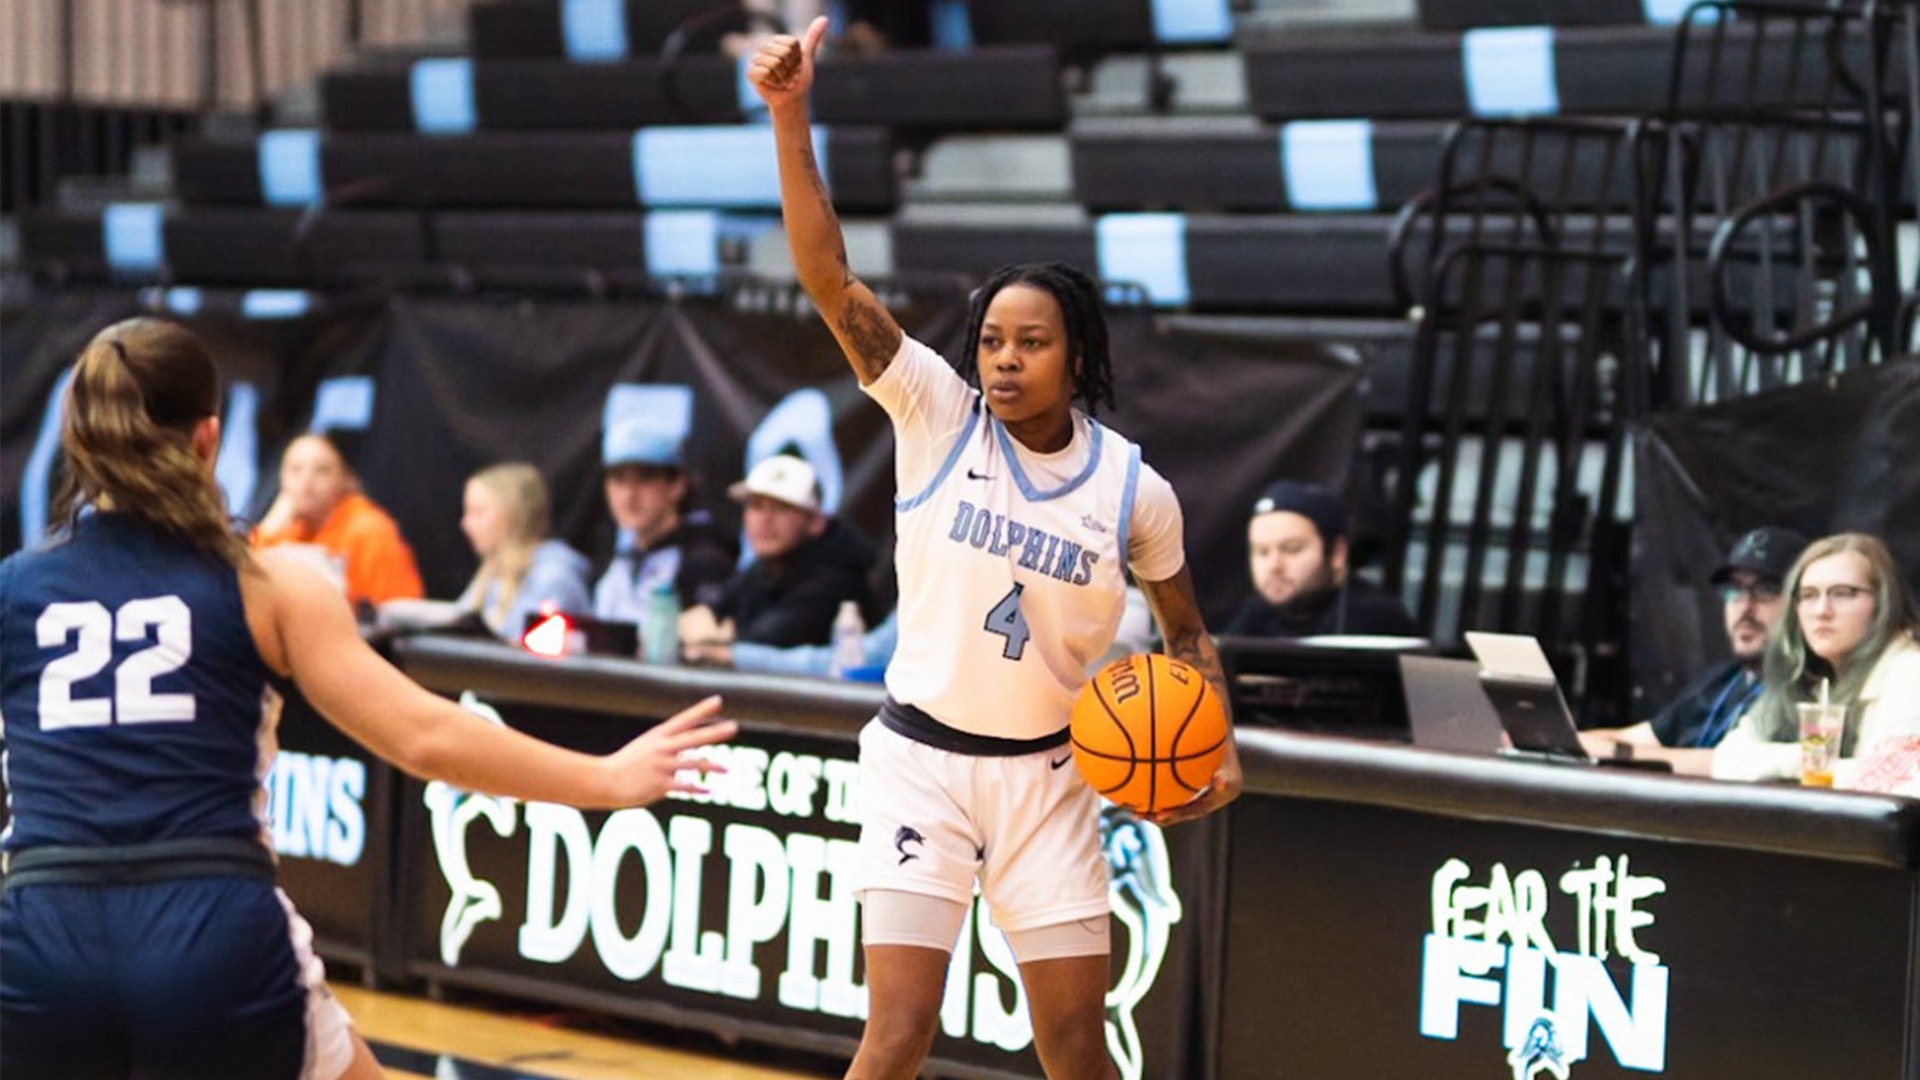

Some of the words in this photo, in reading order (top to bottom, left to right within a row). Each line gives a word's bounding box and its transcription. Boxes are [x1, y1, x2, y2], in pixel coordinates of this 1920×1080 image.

[948, 500, 1100, 587] DOLPHINS
[36, 594, 197, 732] 22
[983, 580, 1030, 661] 4
[766, 751, 824, 818] OF
[518, 800, 1035, 1051] DOLPHS
[1431, 858, 1558, 975] FEAR
[1559, 854, 1667, 966] THE
[1419, 932, 1670, 1073] FIN
